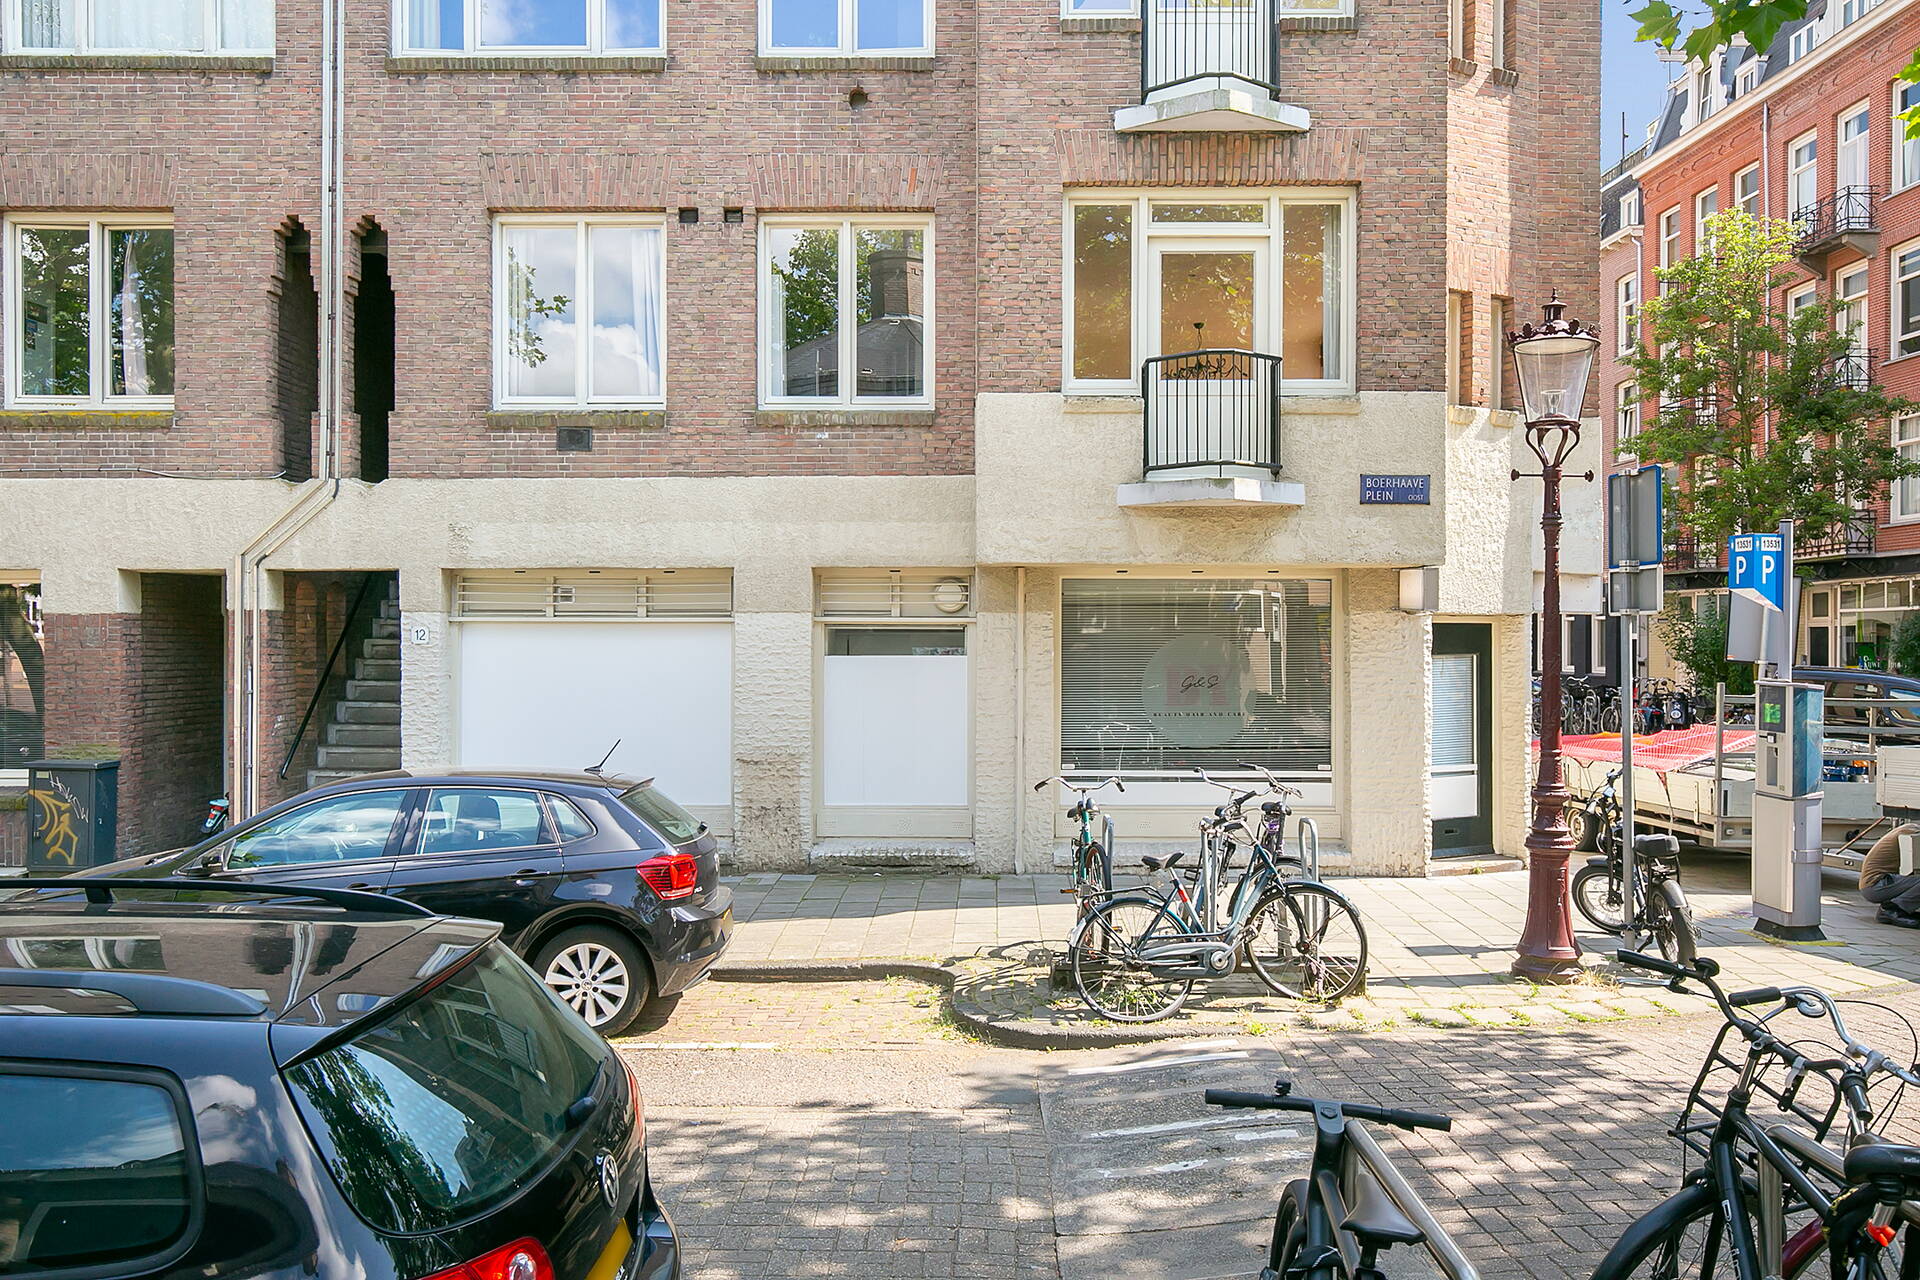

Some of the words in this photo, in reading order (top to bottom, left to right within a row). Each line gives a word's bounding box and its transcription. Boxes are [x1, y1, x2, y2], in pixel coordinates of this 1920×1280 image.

[1366, 478, 1424, 488] BOERHAAVE
[1366, 490, 1393, 501] PLEIN
[1737, 540, 1752, 549] 13531
[1763, 540, 1780, 549] 13531
[1736, 555, 1747, 585] P
[1762, 554, 1775, 585] P
[415, 628, 426, 641] 12
